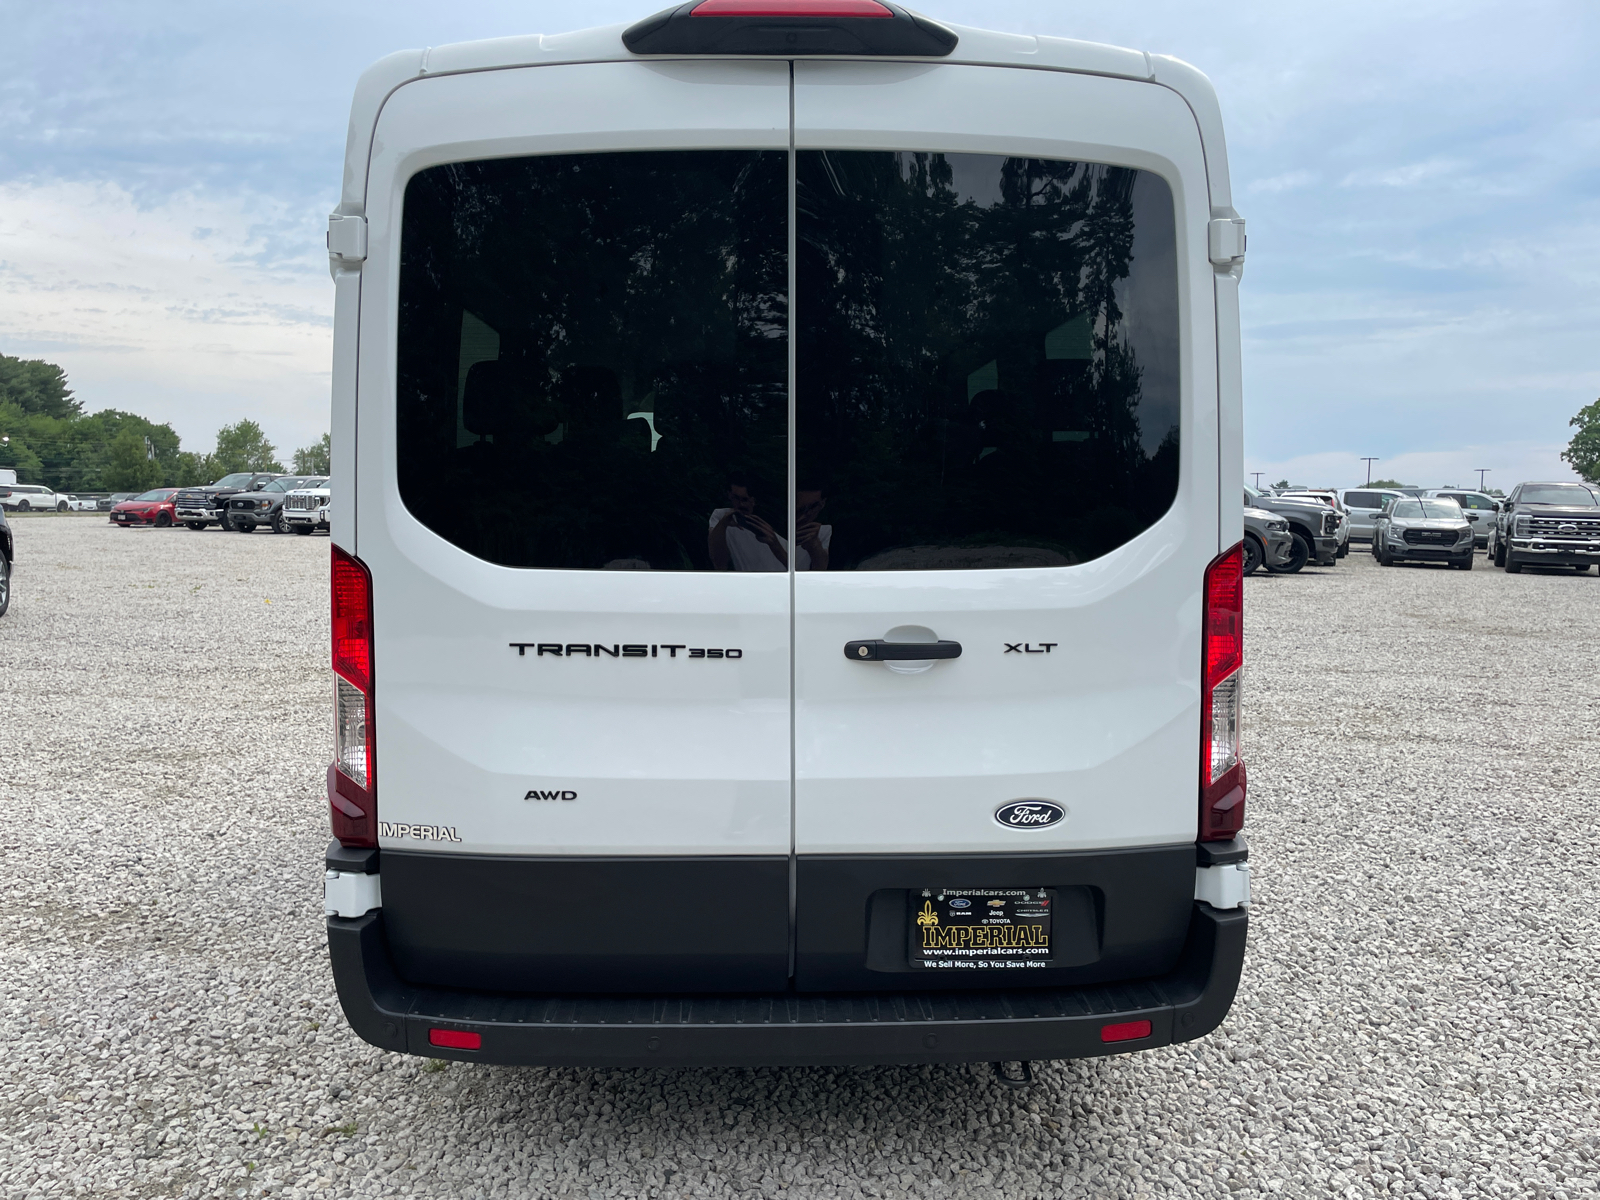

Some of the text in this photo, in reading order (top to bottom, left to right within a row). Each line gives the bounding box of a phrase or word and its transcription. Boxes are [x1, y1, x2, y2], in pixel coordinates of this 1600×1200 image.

[1003, 643, 1059, 654] XLT
[524, 790, 578, 801] AWD
[1009, 805, 1052, 824] Ford
[379, 821, 462, 842] IMPERIAL
[942, 888, 1026, 897] Imperialcars.com
[922, 925, 1048, 947] IMPERIAL
[923, 947, 1049, 956] www.imperialcars.com
[954, 961, 977, 969] More,
[1006, 960, 1025, 968] Save
[1026, 960, 1046, 968] More
